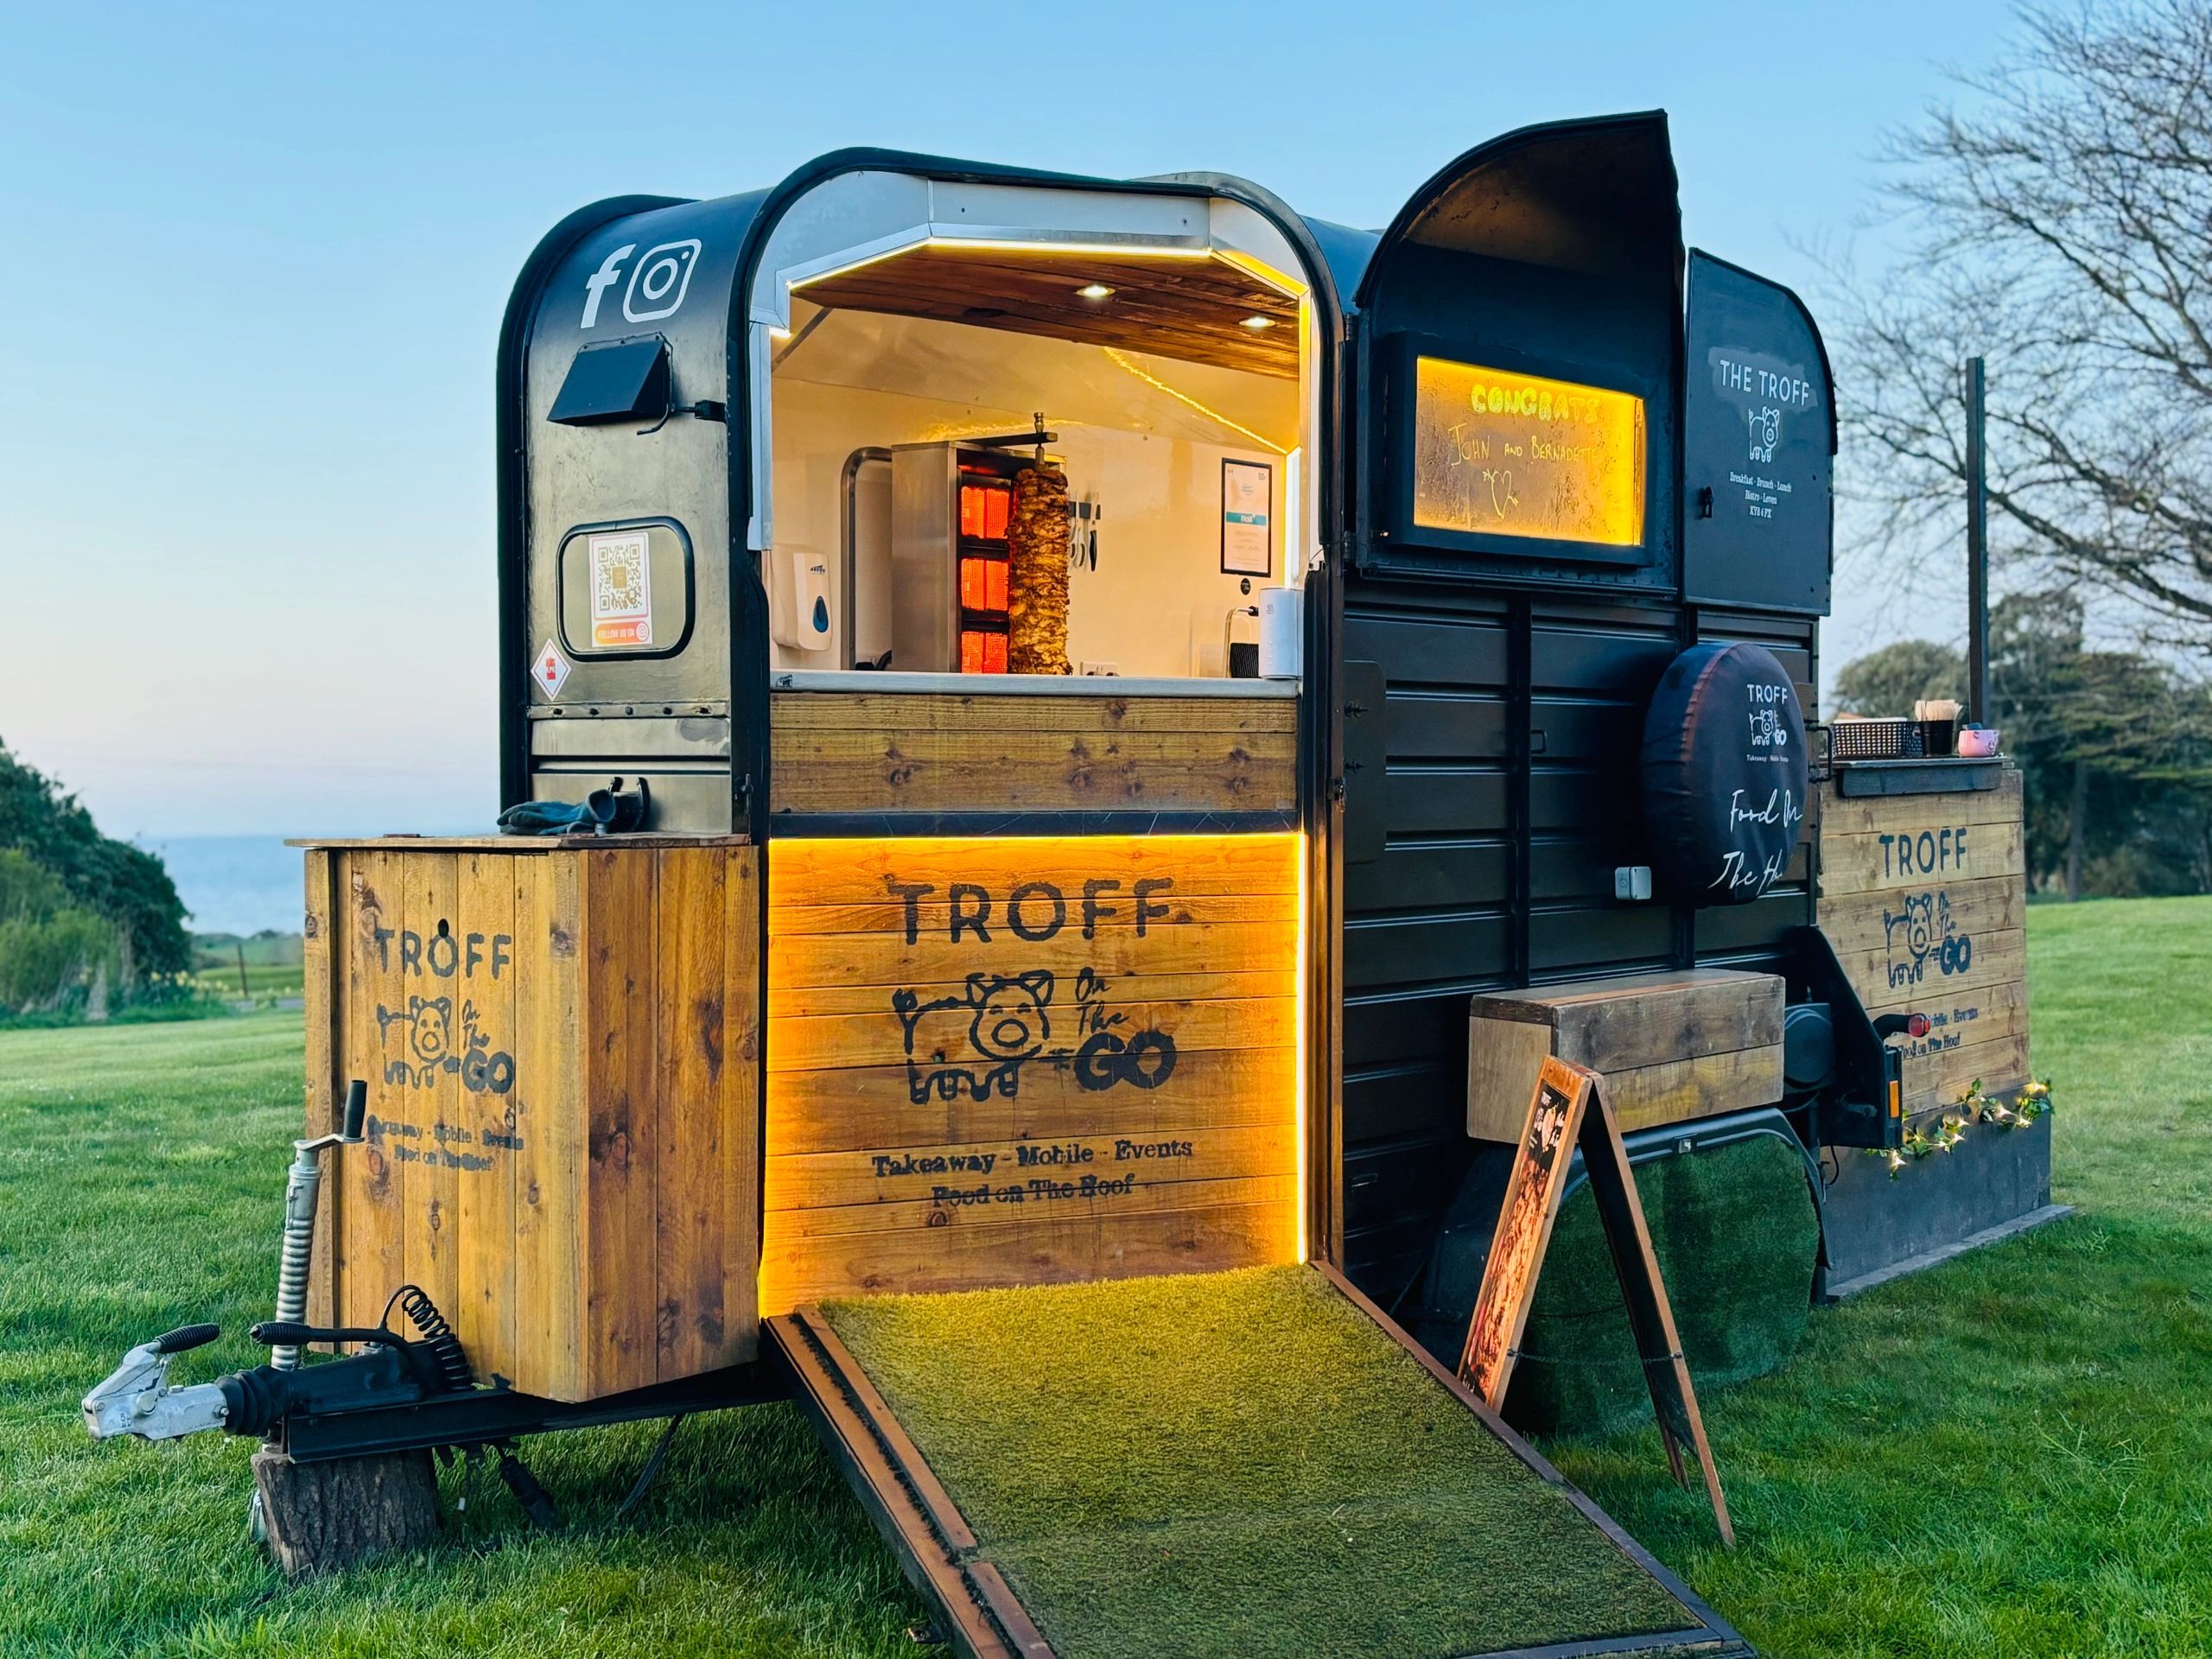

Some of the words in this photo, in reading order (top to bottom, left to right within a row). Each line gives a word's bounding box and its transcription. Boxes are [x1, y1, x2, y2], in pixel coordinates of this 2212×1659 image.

[1719, 359, 1752, 392] THE
[1758, 370, 1809, 406] TROFF
[1471, 384, 1600, 424] CONGRATS
[1448, 423, 1491, 467] JOHN
[1504, 442, 1523, 457] AND
[1729, 471, 1754, 486] Breakfast
[1757, 476, 1774, 490] Brunch
[1777, 480, 1792, 493] Lunch
[1745, 489, 1760, 501] Bistro
[1763, 493, 1777, 505] Leven
[1746, 683, 1788, 705] TROFF
[1775, 728, 1787, 746] GO
[1730, 788, 1780, 834] Food
[1783, 789, 1803, 828] On
[1707, 850, 1758, 889] The
[1878, 827, 1967, 879] TROFF
[887, 877, 1173, 945] TROFF
[374, 927, 512, 980] TROFF
[1940, 933, 1972, 976] GO
[1075, 966, 1111, 1002] On
[1078, 1000, 1129, 1037] The
[1943, 1031, 1961, 1049] Hoof
[461, 1047, 515, 1094] GO
[1075, 1030, 1177, 1091] GO
[871, 1151, 998, 1177] Takeaway
[1015, 1143, 1094, 1166] Mobile
[1115, 1139, 1193, 1161] Events
[931, 1184, 991, 1208] Food
[995, 1185, 1023, 1204] on
[1028, 1179, 1074, 1200] The
[1078, 1173, 1135, 1198] Hoof
